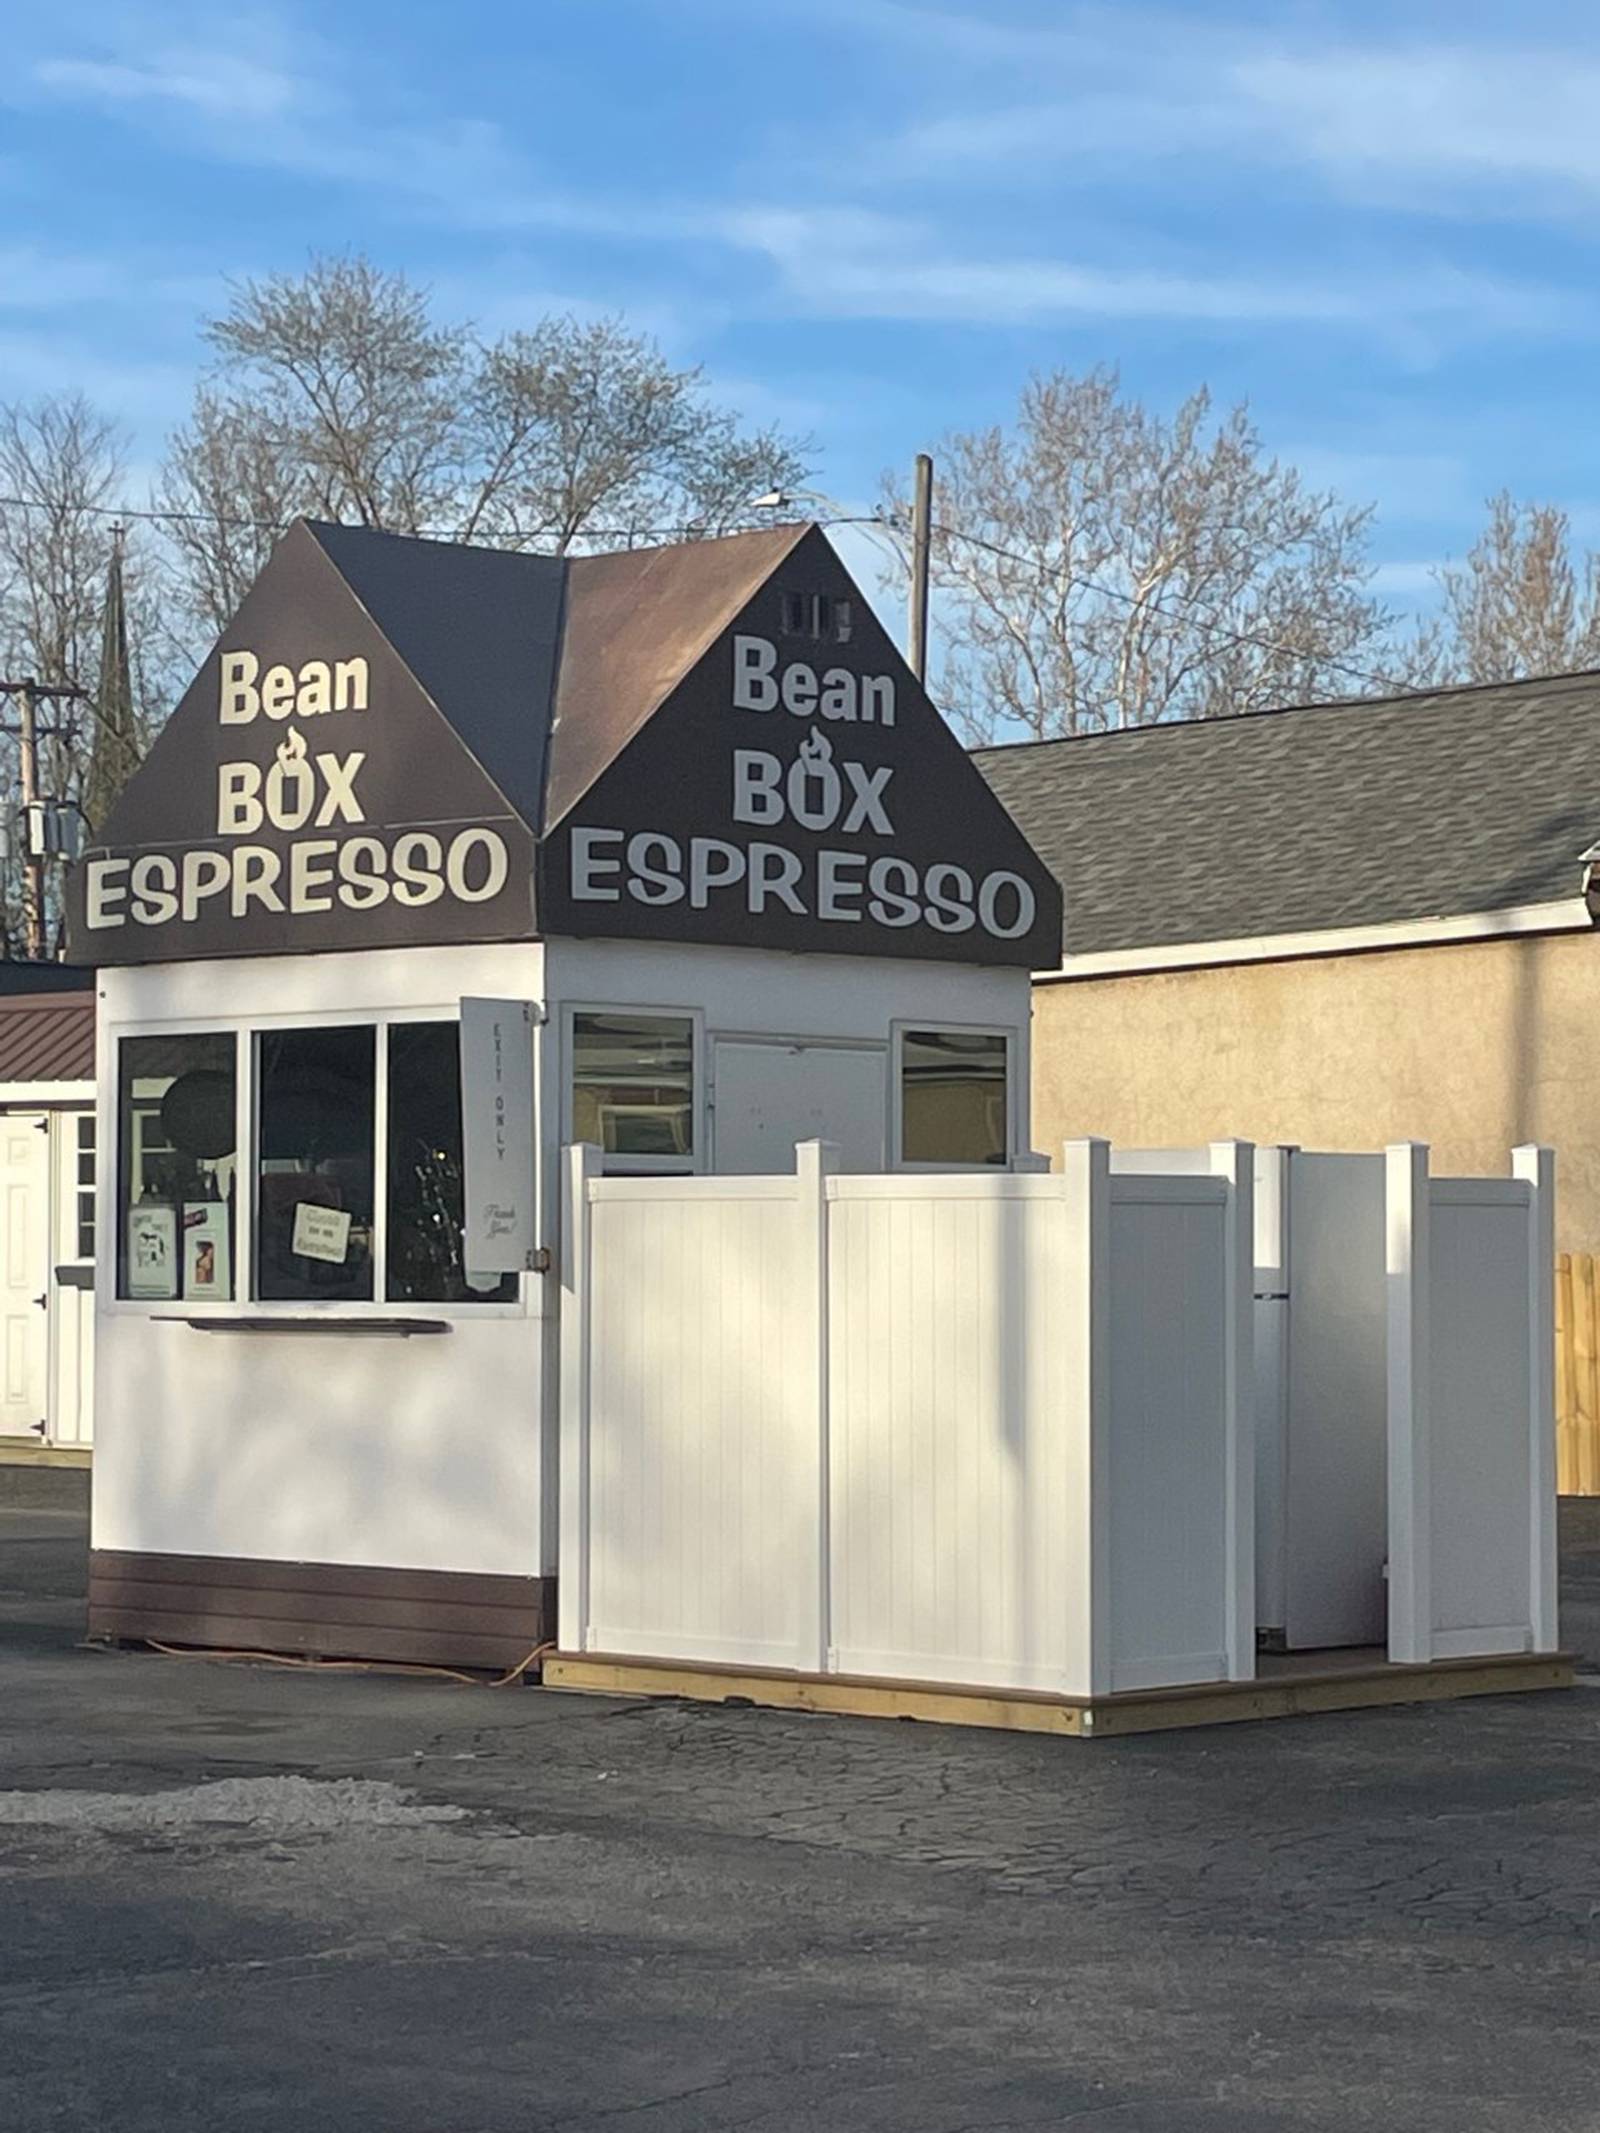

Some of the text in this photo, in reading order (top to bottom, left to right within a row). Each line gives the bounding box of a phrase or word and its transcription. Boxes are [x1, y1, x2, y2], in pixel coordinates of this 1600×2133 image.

[219, 651, 369, 725] Bean
[733, 635, 896, 727] Bean
[218, 748, 366, 835] BOX
[733, 748, 895, 835] BOX
[86, 828, 510, 929] ESPRESSO
[570, 827, 1036, 939] ESPRESSO
[493, 1022, 505, 1161] EXIT ONLY
